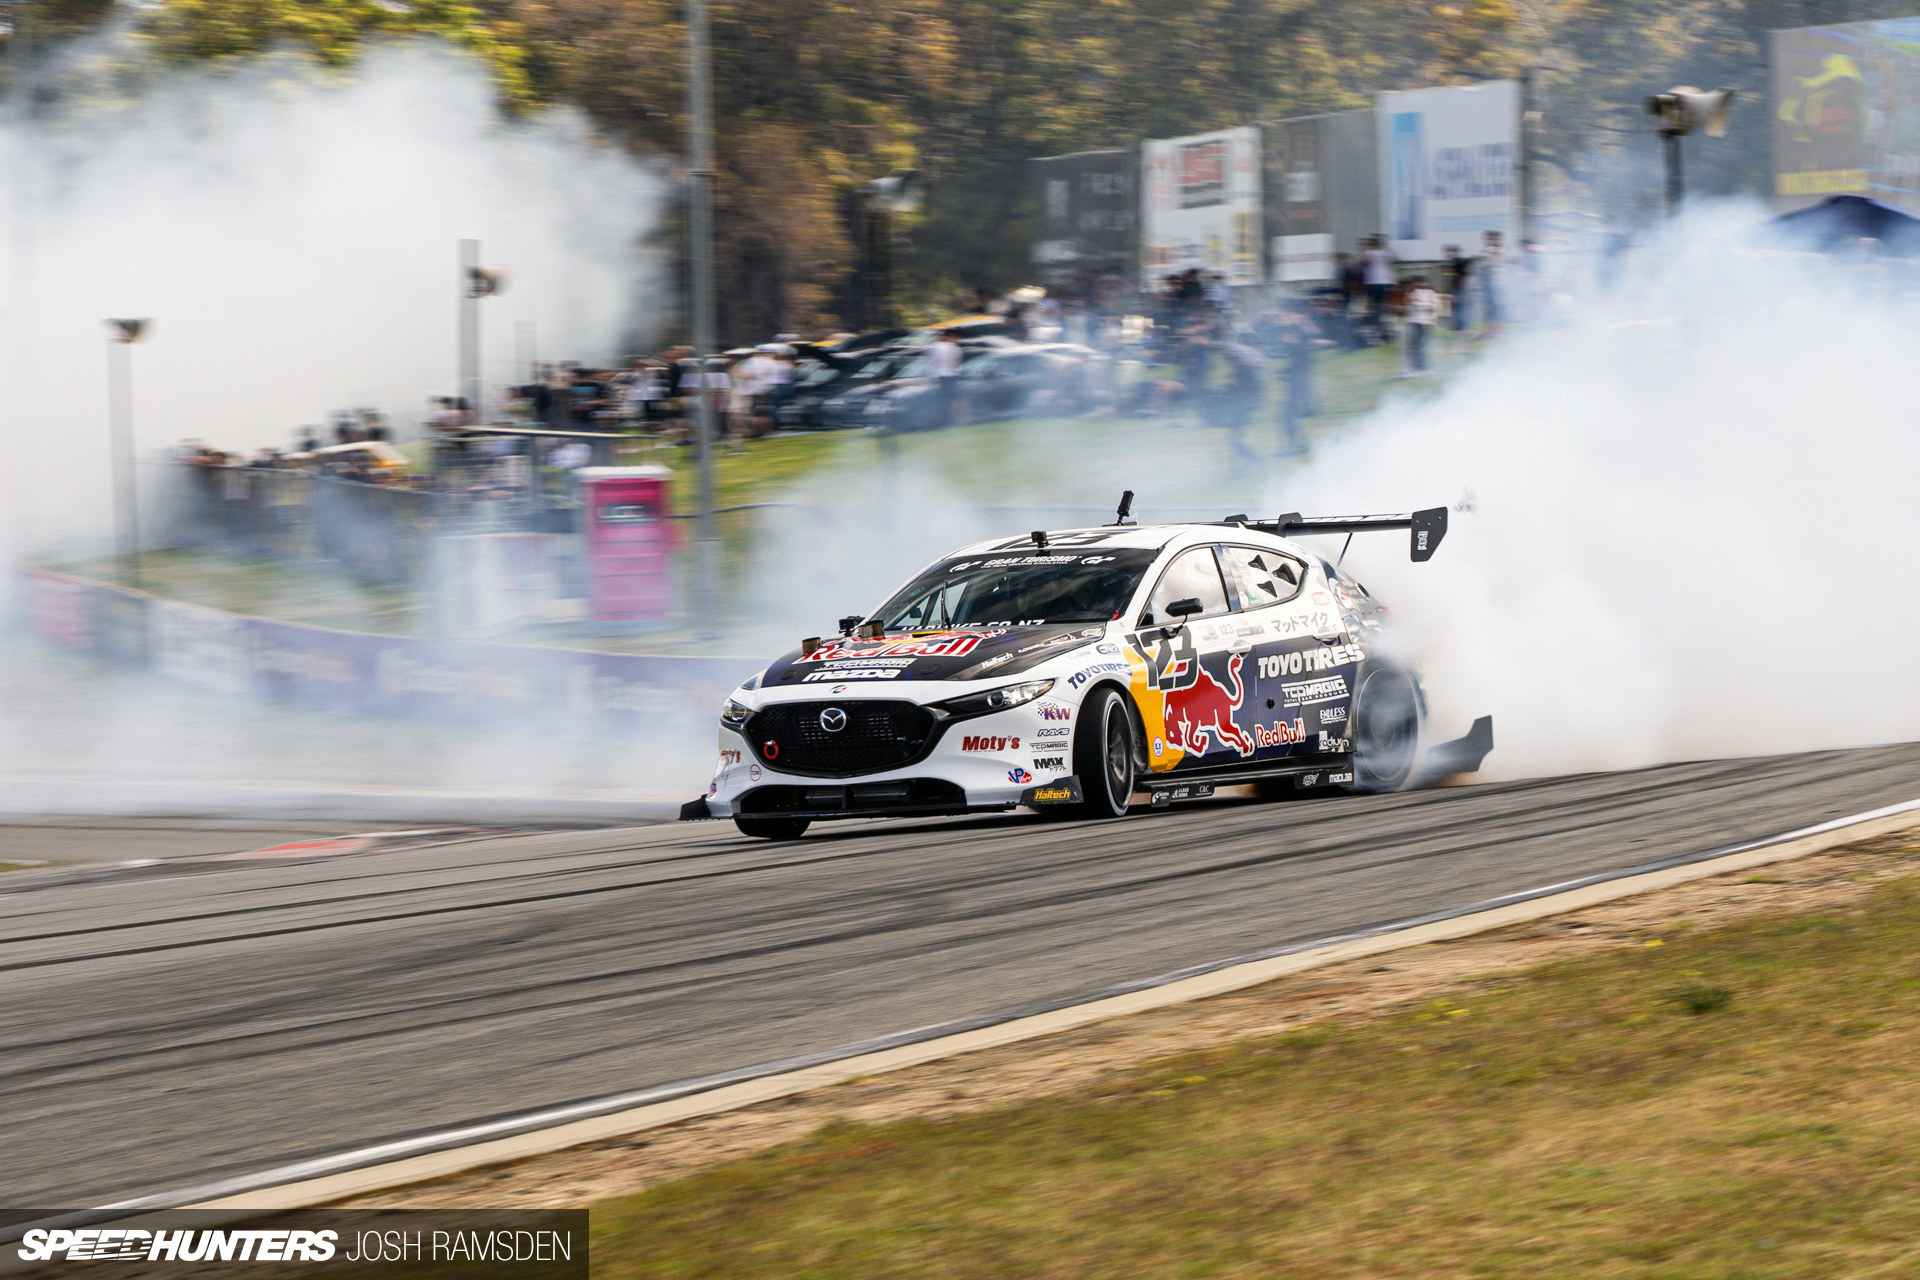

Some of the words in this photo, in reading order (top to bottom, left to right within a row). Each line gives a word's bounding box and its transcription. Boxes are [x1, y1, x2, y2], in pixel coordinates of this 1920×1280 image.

[984, 557, 1023, 567] GRAN
[1271, 612, 1328, 632] マッドマイク
[1219, 624, 1234, 635] 123
[981, 652, 1014, 669] Haltech
[1044, 707, 1071, 720] KW
[1320, 707, 1346, 719] ENDLESS
[1037, 728, 1070, 737] RAYS
[962, 735, 1020, 751] Moty's
[1033, 757, 1064, 770] MAX
[1034, 788, 1071, 801] Haltech
